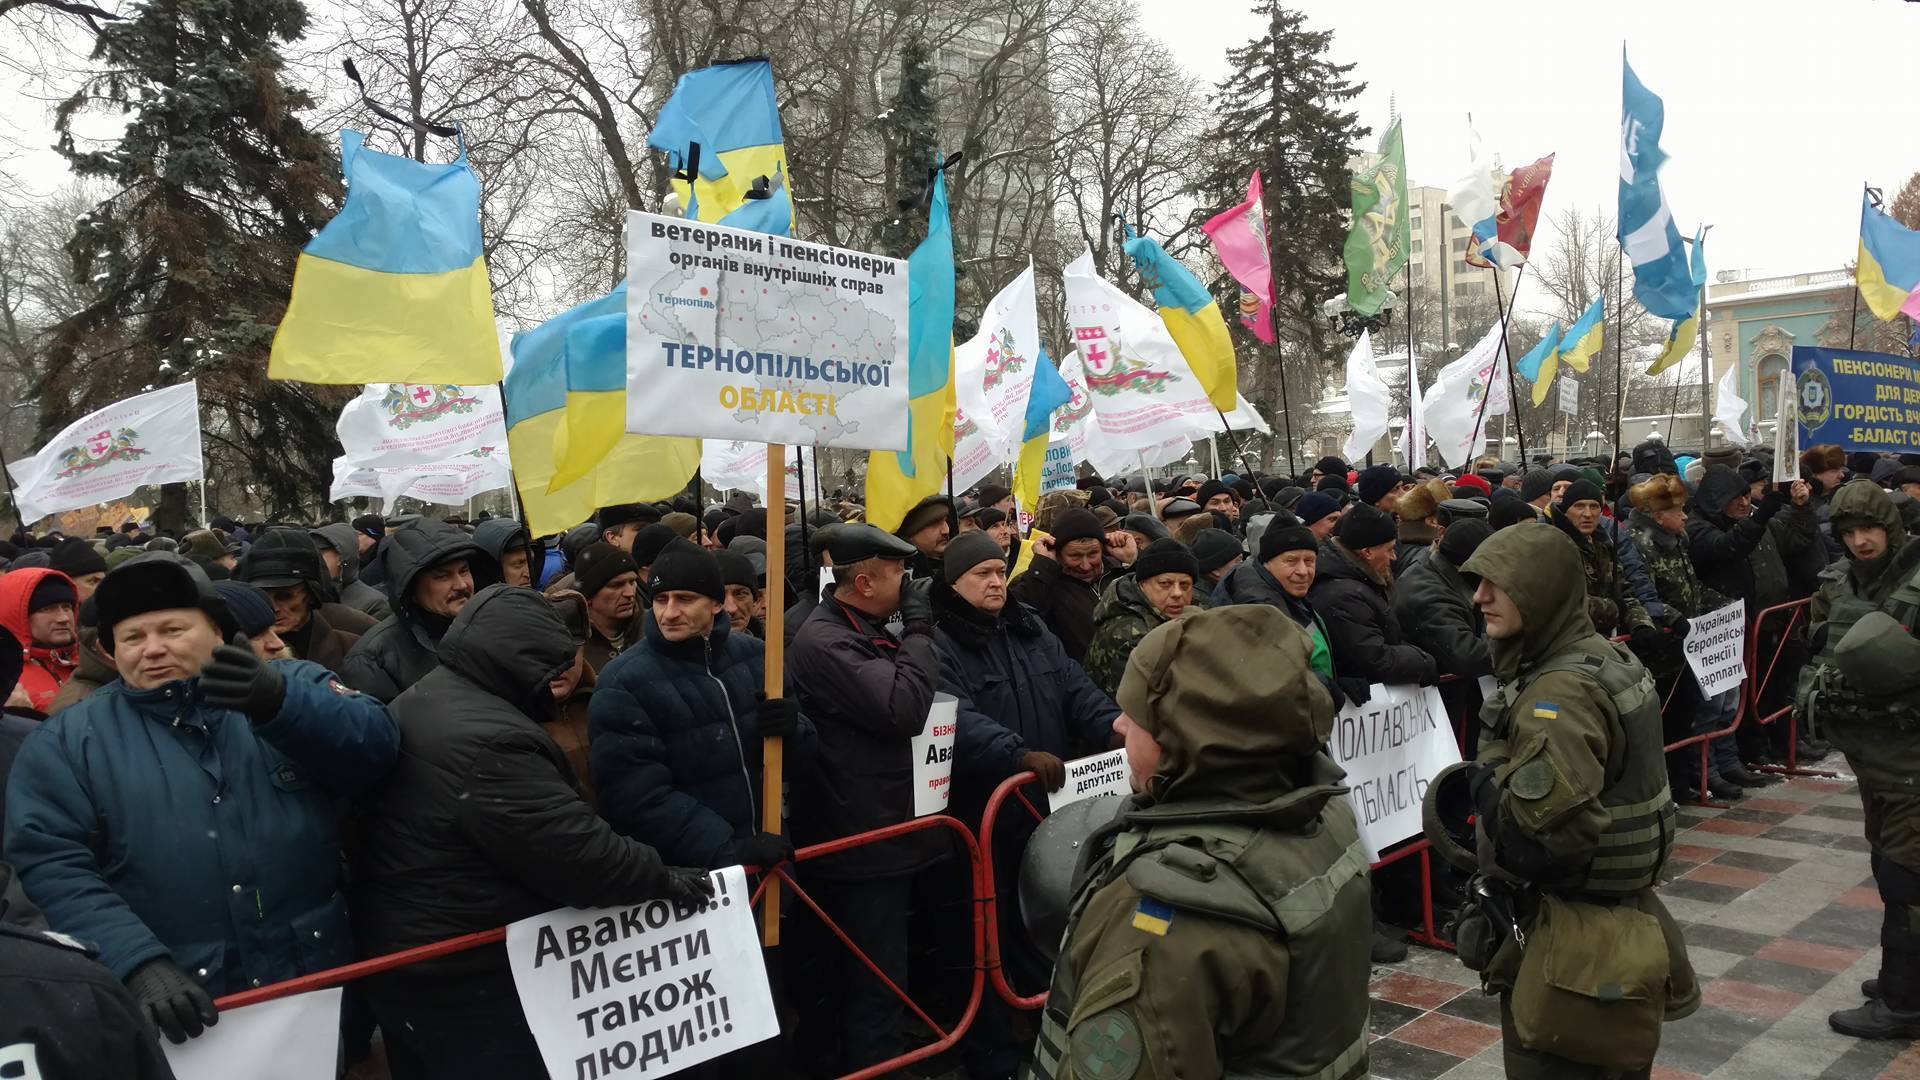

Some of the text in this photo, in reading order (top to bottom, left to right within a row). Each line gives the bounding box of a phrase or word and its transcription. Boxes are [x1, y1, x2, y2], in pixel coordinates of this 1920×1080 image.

[651, 221, 896, 277] ветерани і пенсіонери
[669, 251, 884, 296] органів внутрішніх справ
[657, 292, 715, 310] Тернопіль
[661, 342, 891, 387] ТЕРНОПІЛЬСЬКОЇ
[1832, 358, 1913, 382] ПЕНСІОНЕРИ
[719, 385, 837, 417] ОБЛАСТІ
[1875, 384, 1901, 402] ДЛЯ
[1834, 404, 1920, 426] ГОРДІСТЬ ВЧ
[1695, 608, 1743, 635] Українцям
[1701, 643, 1737, 668] пенсії і
[1700, 662, 1743, 688] зарплати
[1071, 752, 1124, 778] НАРОДНИЙ
[1076, 770, 1124, 795] ДЕПУТАТЕ!
[1353, 762, 1430, 827] ОБЛАСТЬ
[570, 928, 712, 1000] Мєнти
[577, 968, 717, 1039] також
[575, 996, 734, 1080] люди!!!
